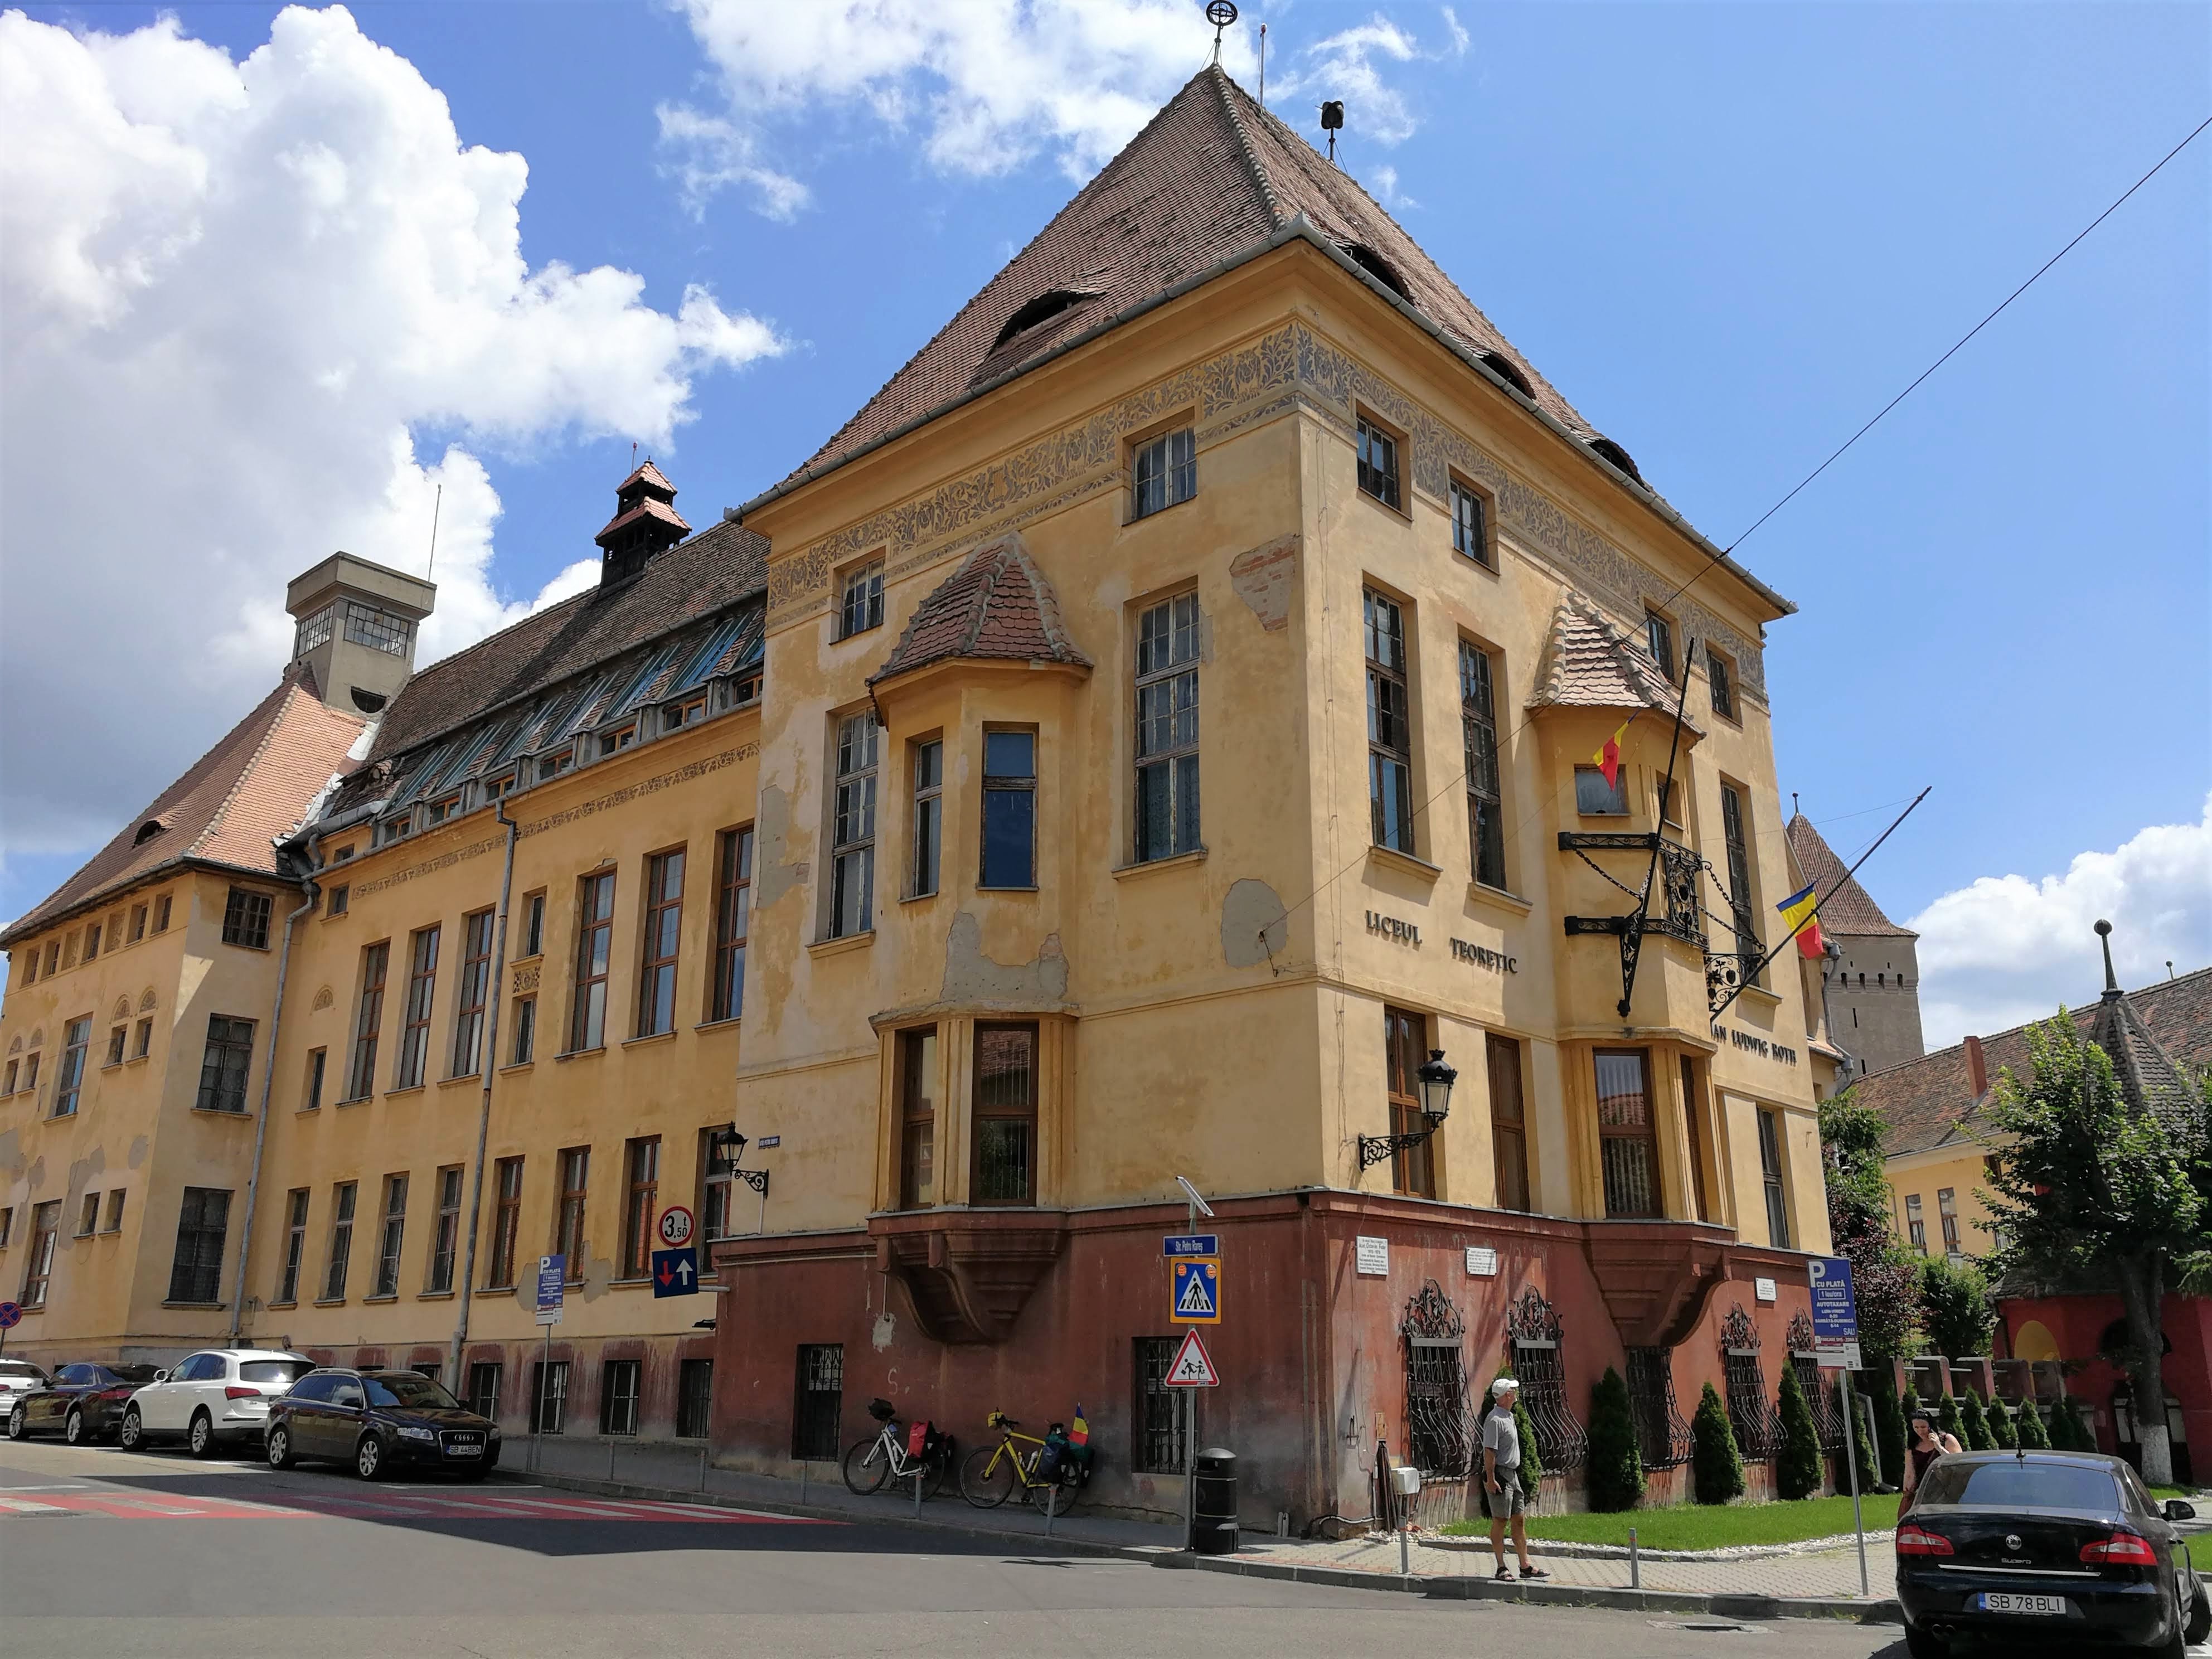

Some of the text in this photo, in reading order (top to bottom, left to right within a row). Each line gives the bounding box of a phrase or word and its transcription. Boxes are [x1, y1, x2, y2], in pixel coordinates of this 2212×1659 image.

[1365, 910, 1518, 974] LICEUL TEORETIC
[1710, 1023, 1797, 1063] AN LUDWIG ROTH
[683, 1216, 687, 1226] t
[540, 1257, 551, 1275] P
[1808, 1261, 1826, 1288] P
[1826, 1279, 1845, 1288] PLATĂ
[1990, 1595, 2010, 1608] SB
[2016, 1597, 2033, 1610] 78
[2036, 1598, 2060, 1611] BLI
